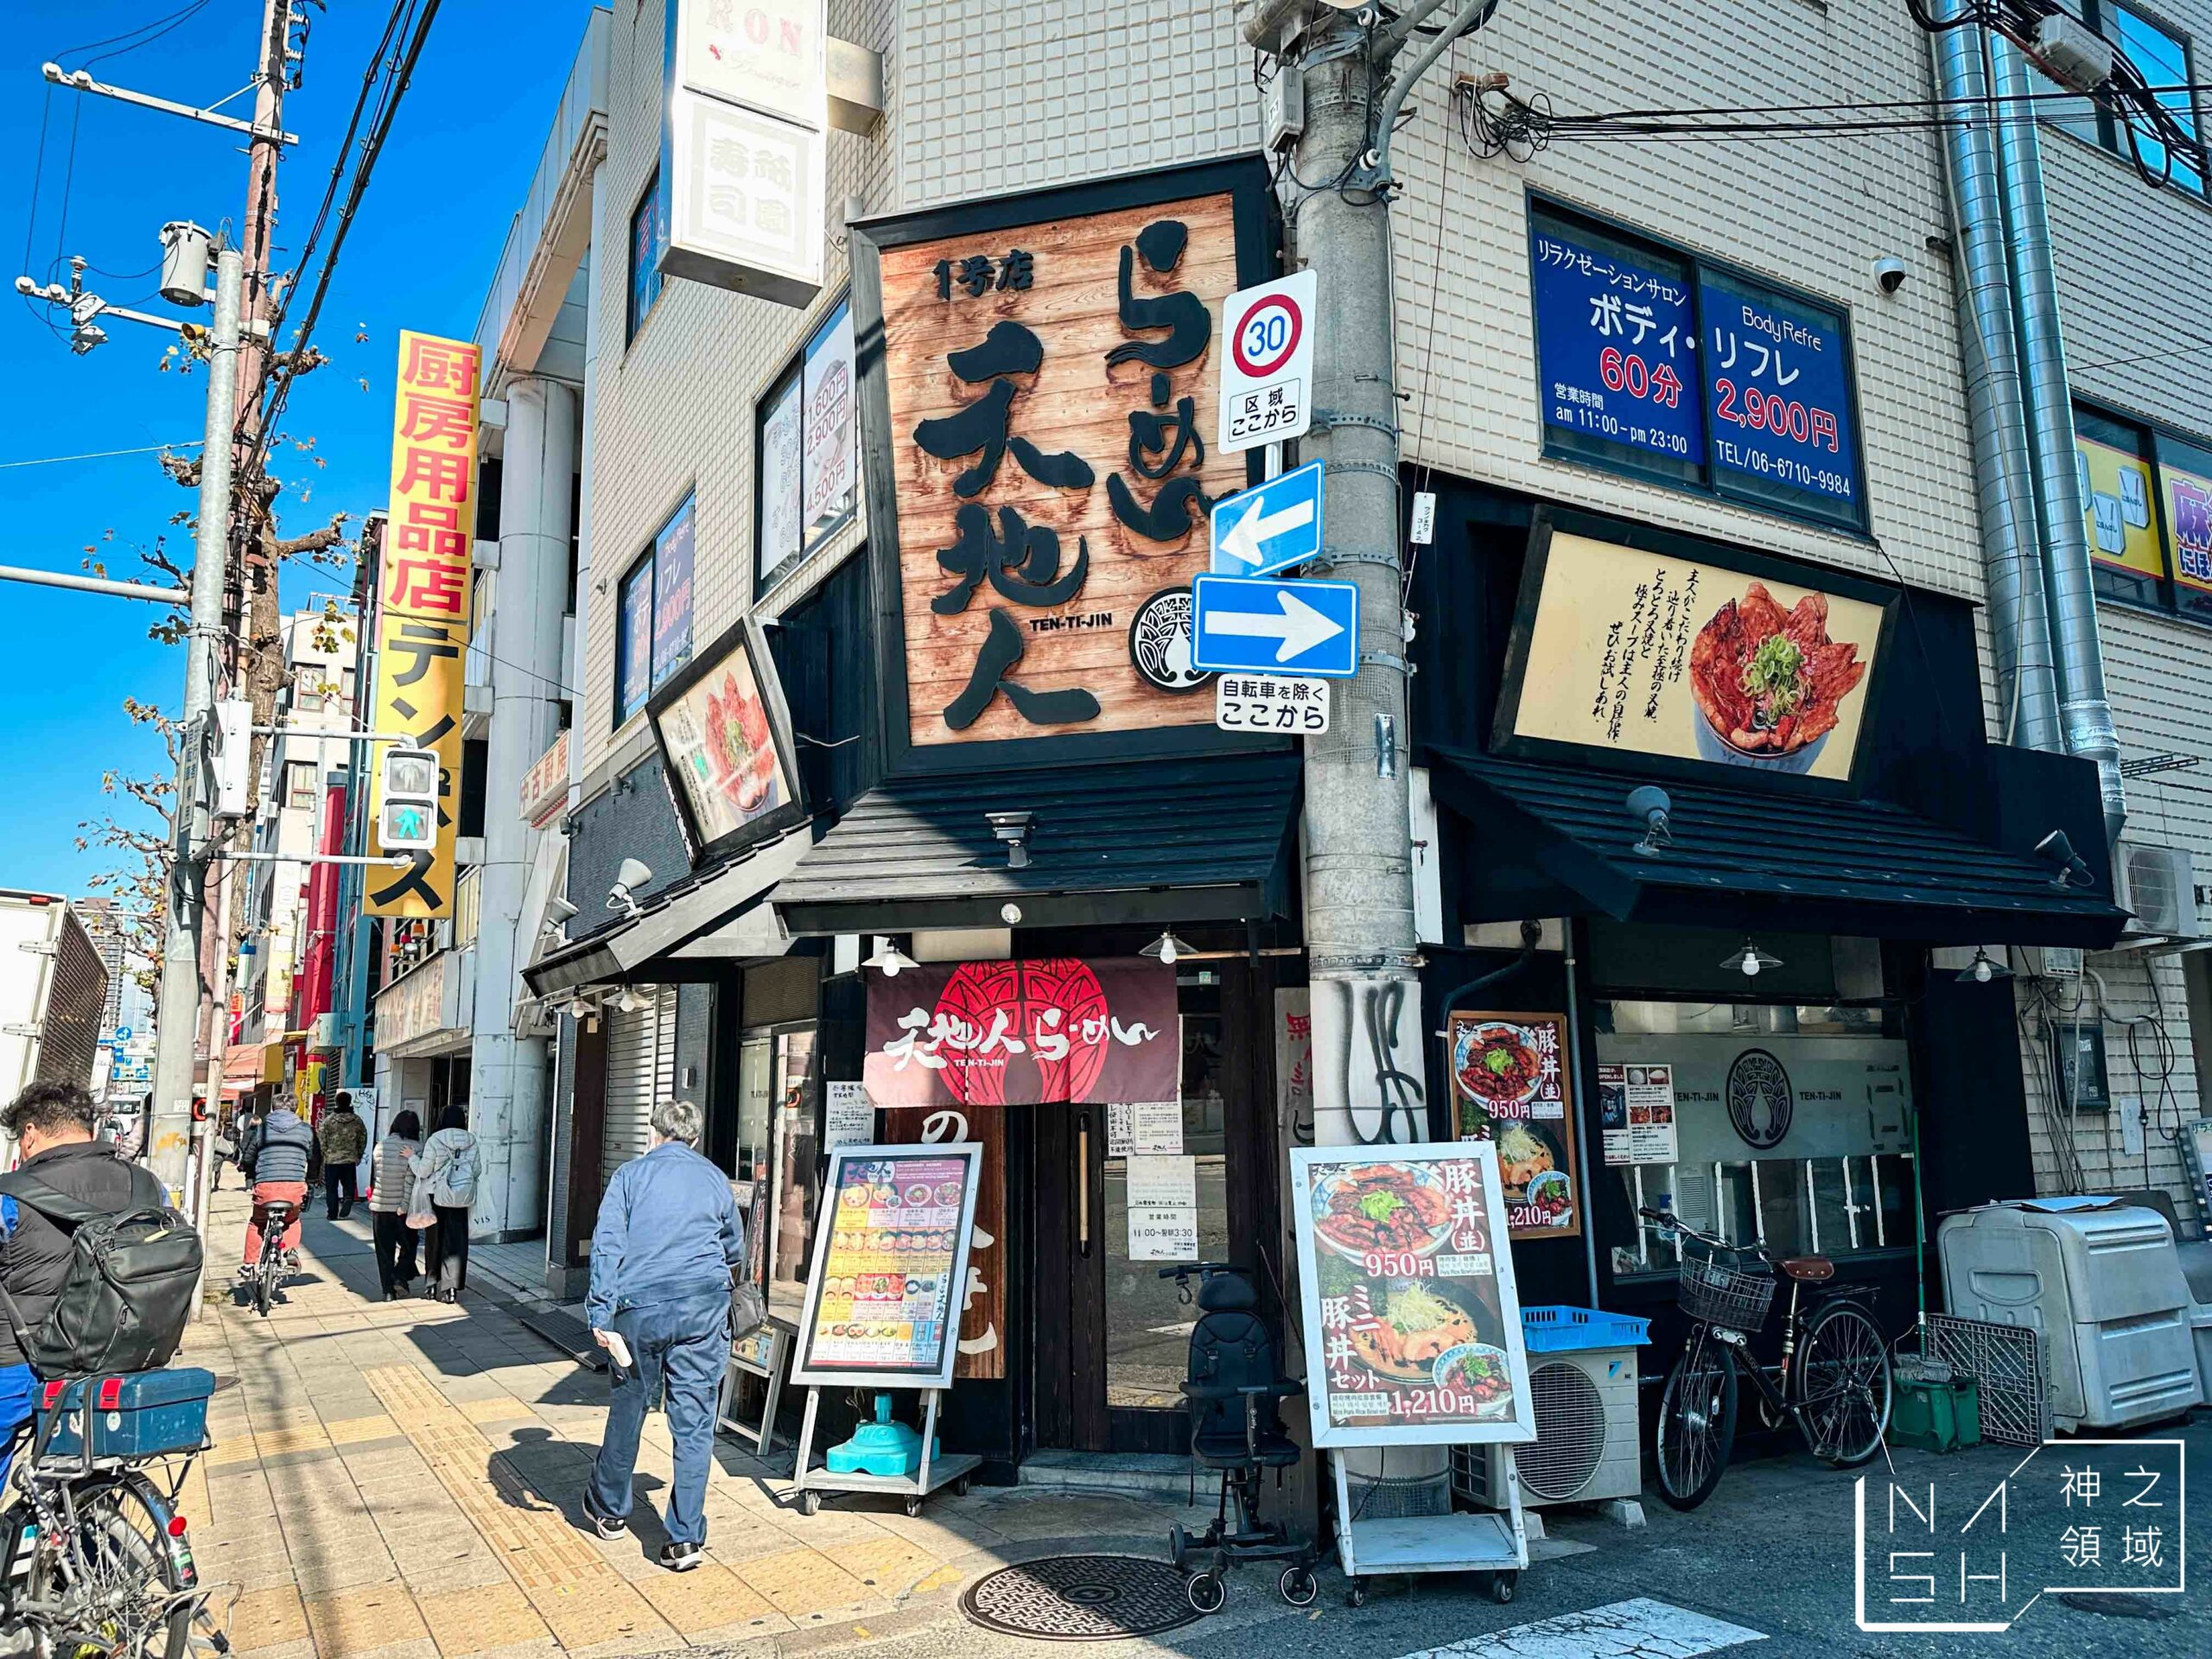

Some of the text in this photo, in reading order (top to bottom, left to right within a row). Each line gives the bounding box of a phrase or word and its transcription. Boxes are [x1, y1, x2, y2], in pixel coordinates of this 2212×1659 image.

[933, 248, 1034, 301] 1号店
[1538, 239, 1687, 307] リラクゼーションサロン
[1248, 315, 1286, 357] 30
[1742, 306, 1821, 352] Body Refre
[1599, 346, 1683, 409] 60分
[1715, 327, 1800, 385] リフレ
[1245, 387, 1283, 414] 区域
[1554, 383, 1605, 410] 営業時間
[1715, 378, 1839, 453] 2,900円
[1231, 404, 1297, 436] ここから
[1556, 406, 1573, 423] am
[1649, 428, 1688, 454] 23:00
[390, 337, 478, 614] 厨房用品店
[1716, 439, 1851, 497] TEL/06-6710-9984
[913, 321, 1102, 730] 天地人
[1030, 612, 1113, 632] TEN-TI-JIN
[1667, 568, 1700, 683] 主人がこだわり続け
[1224, 680, 1324, 702] 自転車を除く
[1222, 702, 1325, 729] ここから
[369, 623, 460, 912] テンス
[1488, 1099, 1530, 1120] 950円
[1799, 1090, 1842, 1101] TEN-TI-JIN
[1365, 1253, 1434, 1277] 950円
[1352, 1285, 1381, 1332] ミニ
[1321, 1298, 1358, 1370] 豚丼
[1331, 1370, 1380, 1390] セット
[1390, 1389, 1475, 1417] 1,210円
